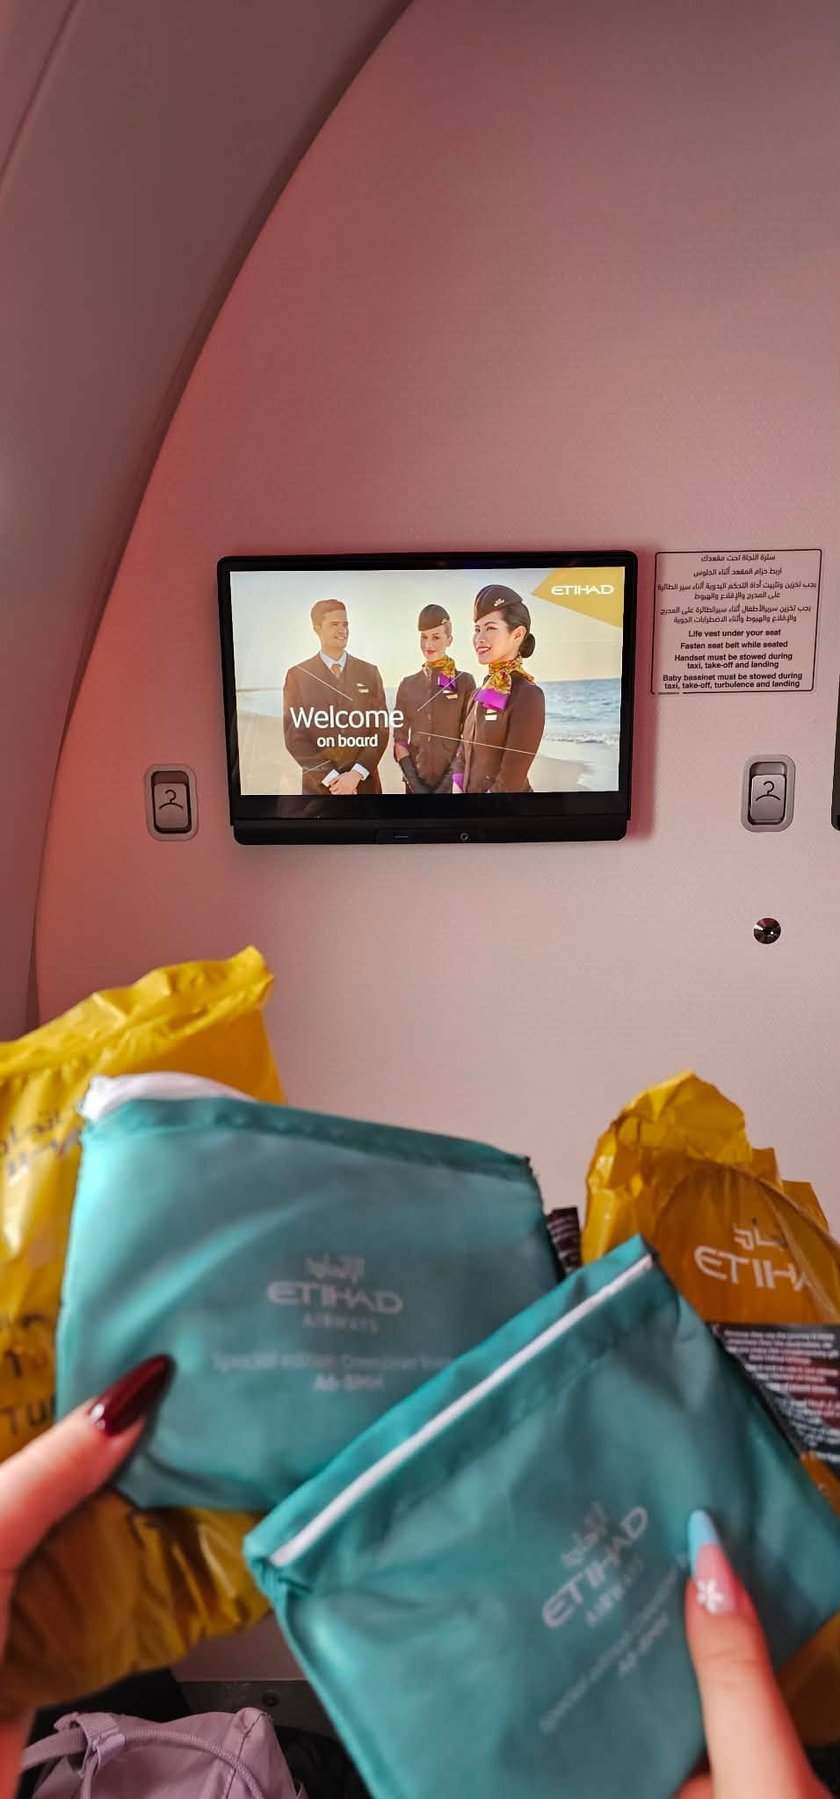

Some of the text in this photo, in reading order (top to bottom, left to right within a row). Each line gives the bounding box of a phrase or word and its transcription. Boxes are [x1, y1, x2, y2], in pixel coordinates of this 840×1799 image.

[742, 553, 759, 562] النجاة
[760, 554, 775, 562] سترة
[693, 569, 717, 577] الجلوس
[718, 566, 731, 576] أثناء
[731, 568, 753, 576] المقعد
[755, 567, 768, 576] حزام
[657, 583, 678, 592] الطائرة
[678, 584, 691, 592] سير
[692, 581, 705, 590] أثناء
[728, 582, 749, 591] التحكم
[750, 579, 762, 589] أداة
[785, 581, 801, 590] تخزين
[802, 582, 817, 590] يجب
[551, 584, 614, 596] ETIHAD
[694, 593, 719, 601] والهبوط
[746, 591, 767, 600] المدرج
[767, 591, 781, 600] على
[660, 607, 680, 616] المدرج
[681, 606, 694, 615] على
[728, 603, 741, 612] أثناء
[780, 604, 796, 613] تخزين
[797, 605, 811, 613] يجب
[674, 616, 693, 625] الجوية
[746, 614, 771, 623] والهبوط
[688, 630, 703, 638] Life
[704, 630, 721, 638] vest
[722, 629, 744, 637] under
[746, 630, 764, 639] your
[680, 642, 706, 650] Fasten
[725, 641, 740, 649] belt
[741, 641, 762, 649] while
[763, 640, 788, 648] seated
[674, 654, 706, 662] Handset
[739, 653, 767, 661] stowed
[768, 653, 793, 662] during
[687, 661, 779, 670] taxi, take-off and landing
[662, 674, 682, 683] Baby
[683, 673, 716, 681] bassinet
[717, 673, 737, 681] must
[749, 672, 776, 680] stowed
[778, 672, 803, 681] during
[664, 680, 801, 690] taxi, take-off, turbulence and landing
[289, 704, 405, 729] Welcome
[316, 733, 379, 748] on board
[266, 1279, 404, 1315] ETIHAD
[541, 1505, 649, 1629] ETIHAD
